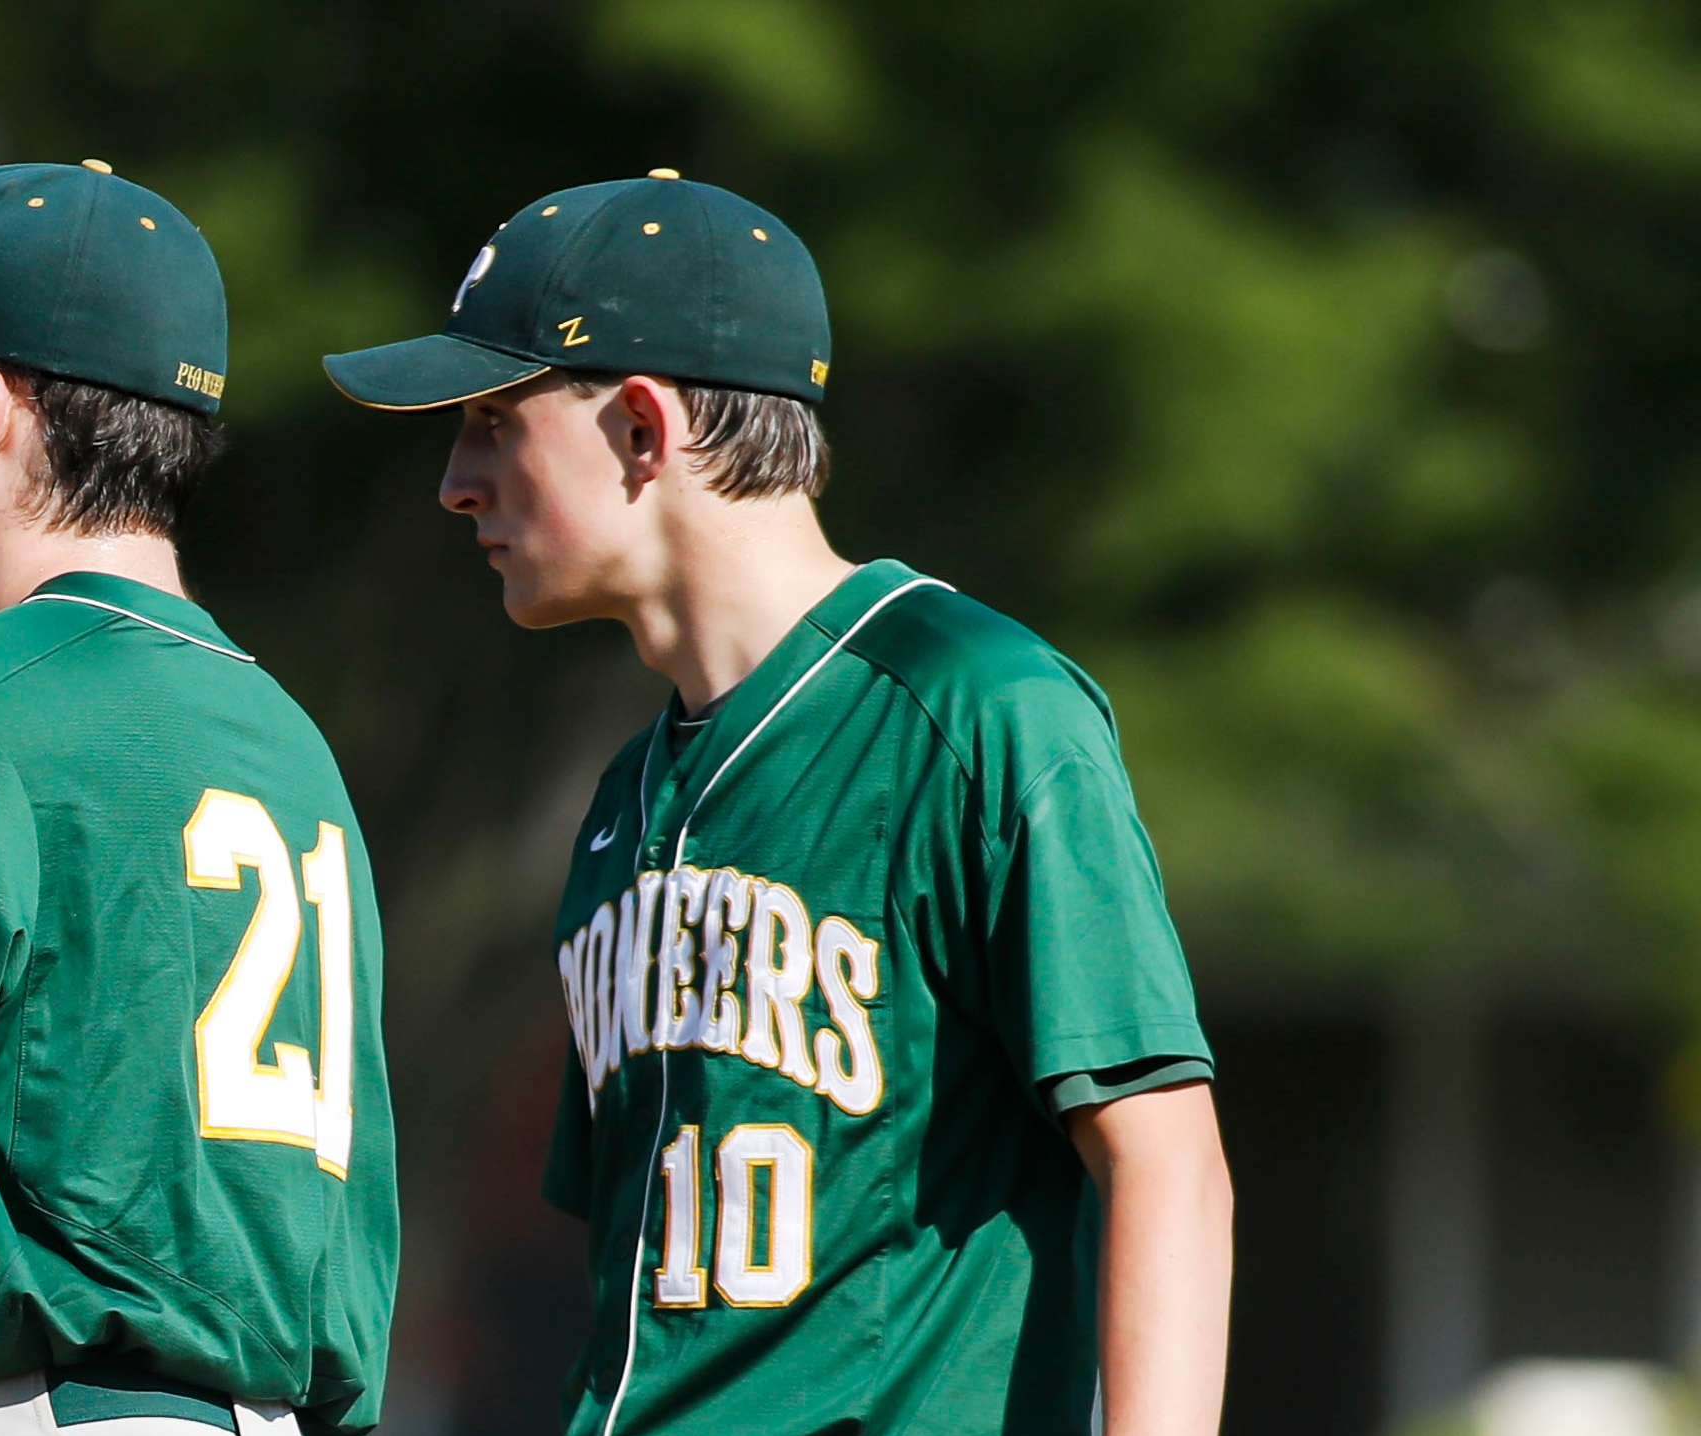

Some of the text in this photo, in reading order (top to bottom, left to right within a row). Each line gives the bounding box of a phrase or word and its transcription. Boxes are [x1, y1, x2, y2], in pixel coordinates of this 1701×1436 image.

[557, 316, 590, 348] Z
[182, 787, 354, 1182] 21
[654, 1122, 816, 1308] 10
